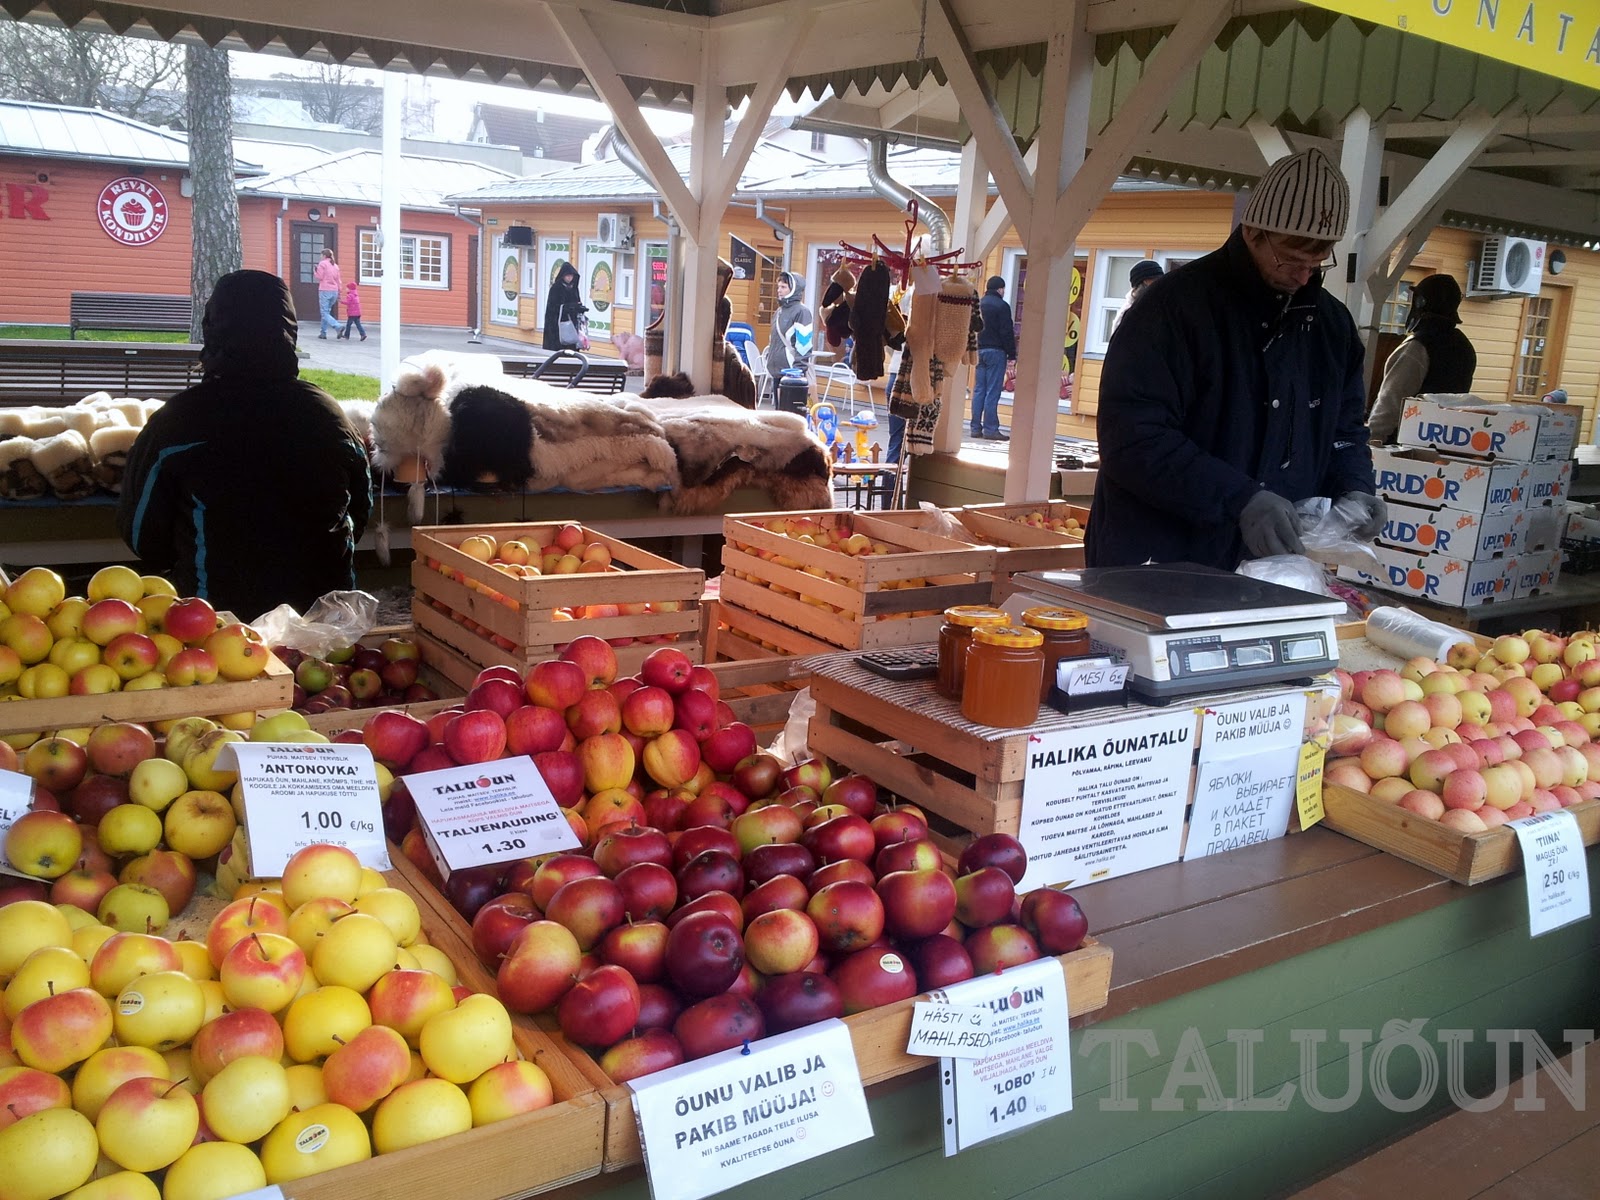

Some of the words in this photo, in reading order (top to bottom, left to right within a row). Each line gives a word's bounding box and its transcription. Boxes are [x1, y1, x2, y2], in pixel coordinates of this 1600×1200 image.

[110, 181, 154, 198] REVAL
[101, 210, 165, 242] KONDIITER
[1381, 514, 1450, 552] RUD'OR
[1074, 671, 1105, 686] MESI
[1217, 712, 1247, 726] ÕUNU
[1250, 706, 1276, 720] VALIB
[1278, 703, 1290, 716] JA
[1215, 729, 1246, 742] PAKIB
[1249, 721, 1281, 736] MÜÜJA
[1031, 744, 1097, 769] HALIKA
[1103, 728, 1188, 757] ÕUNATALU
[1071, 767, 1102, 776] PÕLVAMAA,
[1104, 763, 1124, 771] RÄPINA,
[1125, 756, 1152, 767] LEEVAKU
[491, 786, 517, 795] TERVISLIK
[1078, 784, 1098, 793] HALIKA
[1099, 781, 1112, 789] TALU
[1114, 778, 1132, 786] ÕUNAD
[1208, 770, 1253, 793] ЯБЛОКИ
[1236, 775, 1295, 800] ВЫБИРАЕТ
[471, 798, 507, 808] Facebookist
[1045, 796, 1075, 807] KODUSELT
[1076, 791, 1100, 801] PUHTALT
[1101, 785, 1135, 797] KASVATATUD,
[1137, 779, 1161, 789] MAITSVAD
[431, 811, 488, 824] HAPUKASMAGUSA
[488, 806, 519, 815] MEELDIVA
[519, 800, 550, 809] MAITSEGA
[468, 815, 485, 823] KÜPS
[486, 812, 508, 821] VALMIS
[509, 809, 522, 817] ÕUN
[1031, 817, 1054, 827] KÜPSED
[1055, 813, 1074, 823] ÕUNAD
[1084, 805, 1112, 816] KORJATUD
[1158, 791, 1177, 800] ÕRNALT
[1211, 809, 1218, 821] И
[1223, 796, 1273, 819] КЛАДЁТ
[301, 811, 342, 831] 1.00
[350, 820, 374, 833] €/kg
[1041, 832, 1065, 841] TUGEVA
[1066, 827, 1087, 836] MAITSE
[1097, 819, 1125, 830] LÕHNAGA,
[1127, 813, 1155, 823] MAHLASED
[1214, 823, 1221, 836] В
[1225, 812, 1266, 833] ПАКЕТ
[310, 838, 347, 847] halikaee
[481, 838, 527, 854] 1.30
[1029, 853, 1052, 863] HOITUD
[1053, 846, 1080, 858] JAHEDAS
[1081, 835, 1131, 851] VENTILEERITAVAS
[1132, 829, 1155, 840] HOIDLAS
[1156, 826, 1168, 834] ILMA
[1206, 828, 1270, 857] ПРОДАВЕЦ
[1535, 849, 1556, 862] MAGUS
[1556, 845, 1568, 855] ÕUN
[1544, 869, 1564, 888] 2.50
[923, 1007, 963, 1024] HÄSTI
[1020, 1008, 1043, 1019] TERVISLIK
[913, 1029, 990, 1048] MAHLASED
[1025, 1036, 1053, 1049] MEELDIVA
[1034, 1044, 1053, 1056] VALGE
[1019, 1059, 1035, 1069] KÜPS
[1036, 1054, 1048, 1065] ÕUN
[675, 1083, 733, 1117] ÕUNU
[739, 1063, 797, 1095] VALIB
[802, 1054, 826, 1076] JA
[675, 1114, 737, 1150] PAKIB
[743, 1086, 816, 1127] MÜÜJA!
[990, 1095, 1027, 1124] 1.40
[701, 1149, 713, 1158] NII
[714, 1139, 741, 1154] SAAME
[742, 1128, 774, 1145] TAGADA
[774, 1121, 796, 1133] TEILE
[797, 1110, 820, 1126] ILUSA
[720, 1145, 772, 1169] KVALITEETSE
[773, 1135, 796, 1150] ÕUNA
